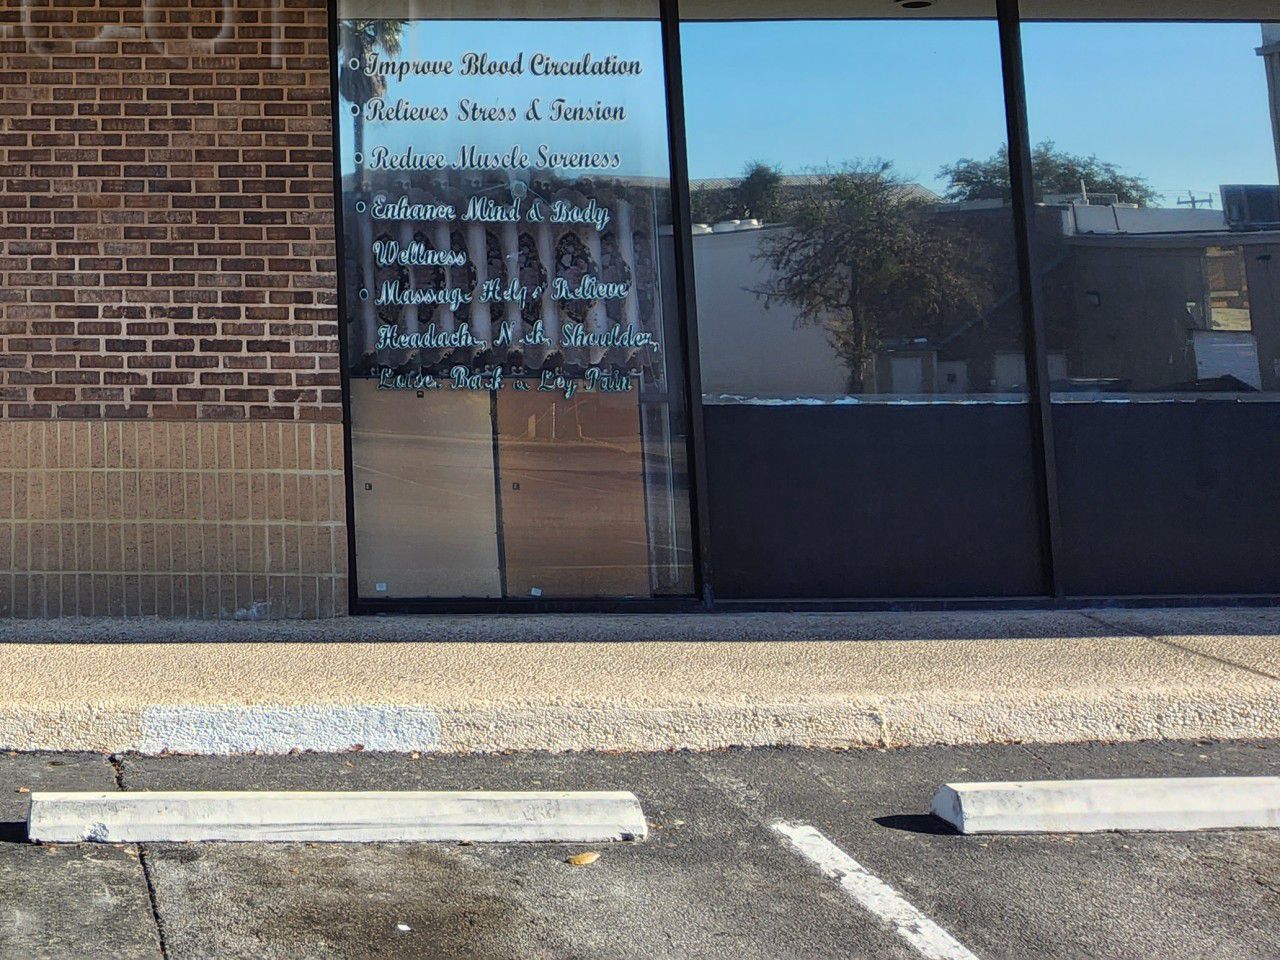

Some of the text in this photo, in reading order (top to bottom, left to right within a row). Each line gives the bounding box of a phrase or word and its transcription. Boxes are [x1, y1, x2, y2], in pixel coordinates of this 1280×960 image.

[364, 52, 642, 82] Improve Blood Circulation
[365, 97, 627, 122] Relieves Stress & Tension
[370, 144, 620, 170] Reduce Muscle Soreness
[371, 194, 456, 222] Enhance
[461, 195, 521, 223] Mind
[550, 199, 610, 232] Body
[373, 240, 467, 267] Wellness
[375, 279, 472, 312] Massage
